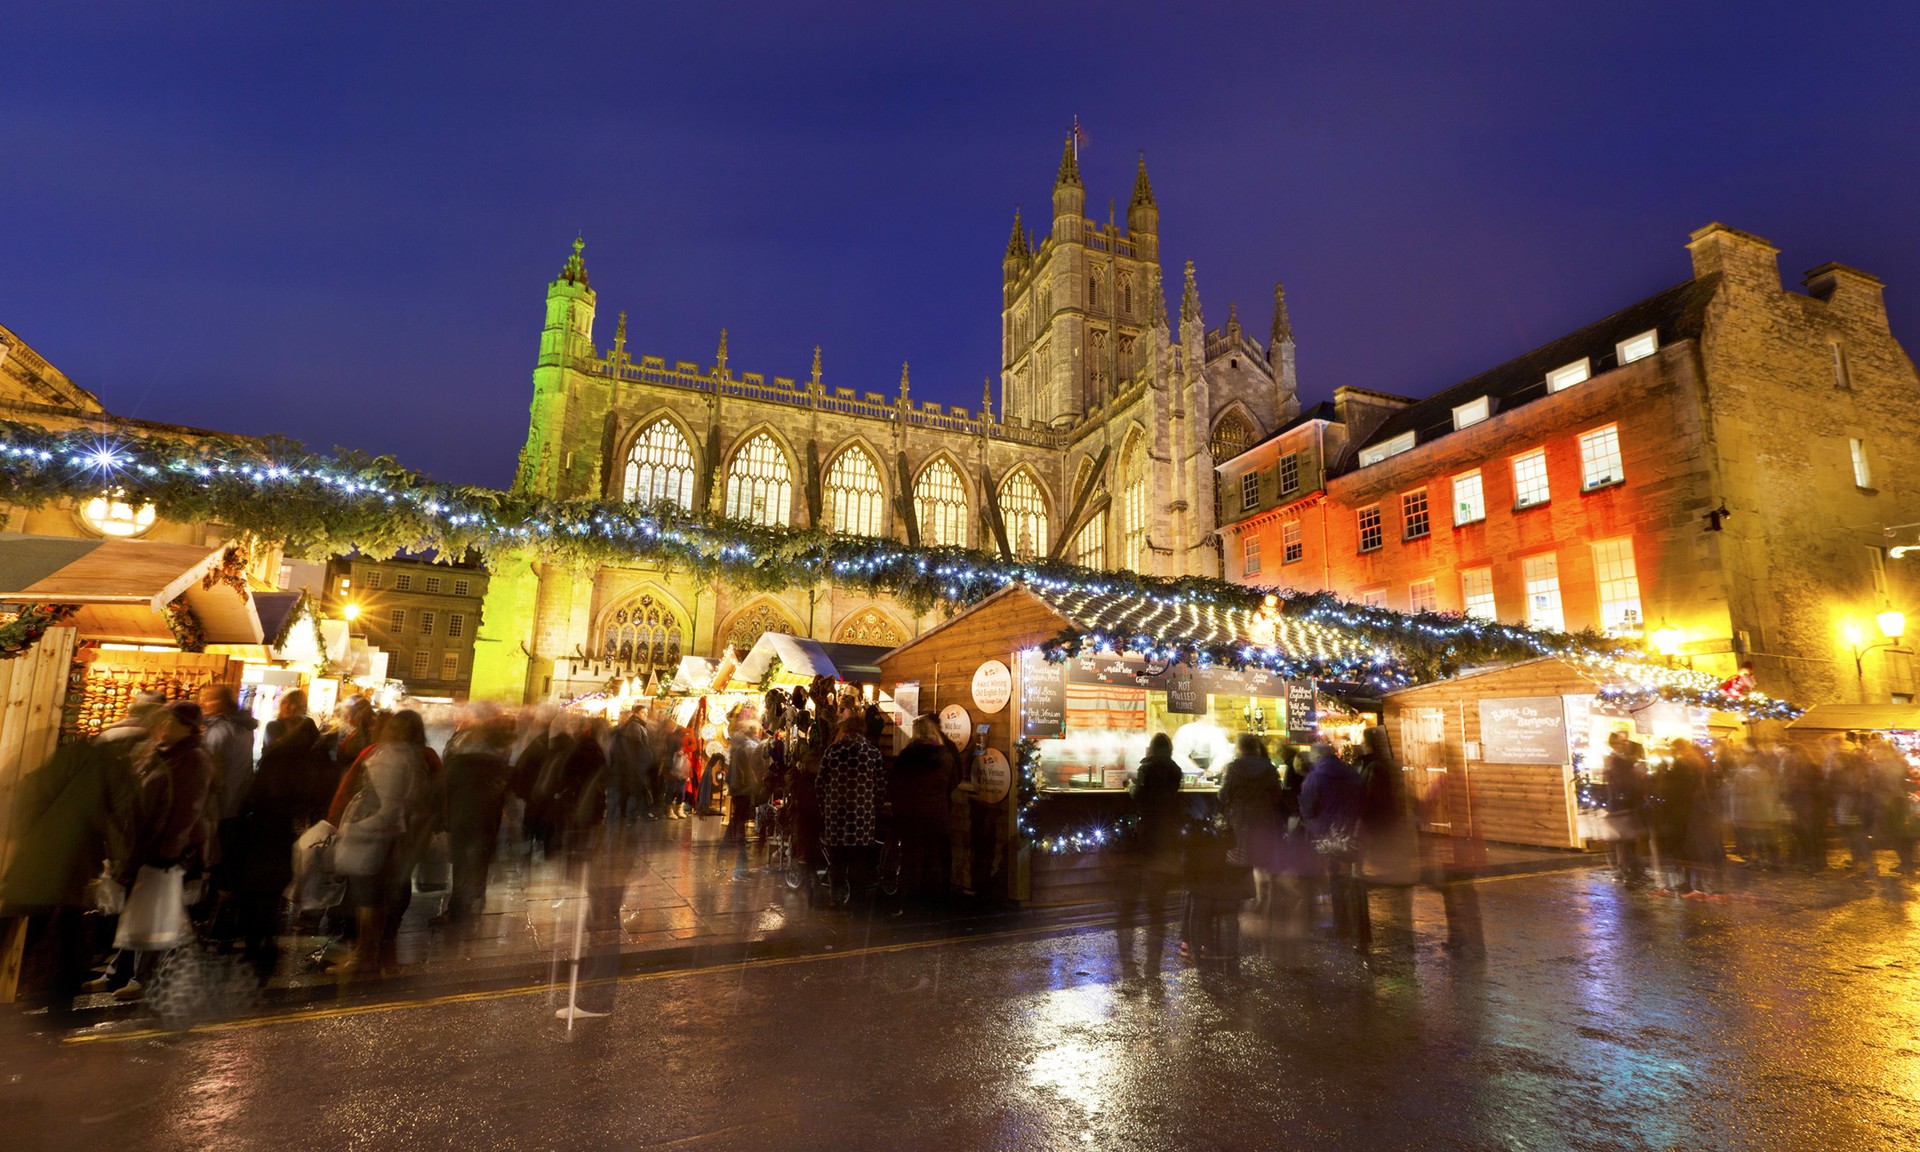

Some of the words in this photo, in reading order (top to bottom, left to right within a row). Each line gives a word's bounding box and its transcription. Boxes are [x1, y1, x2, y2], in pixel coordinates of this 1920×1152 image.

[1177, 680, 1191, 690] HOT
[1171, 690, 1197, 701] MULLED
[1490, 707, 1520, 722] Bang
[1522, 706, 1538, 717] On
